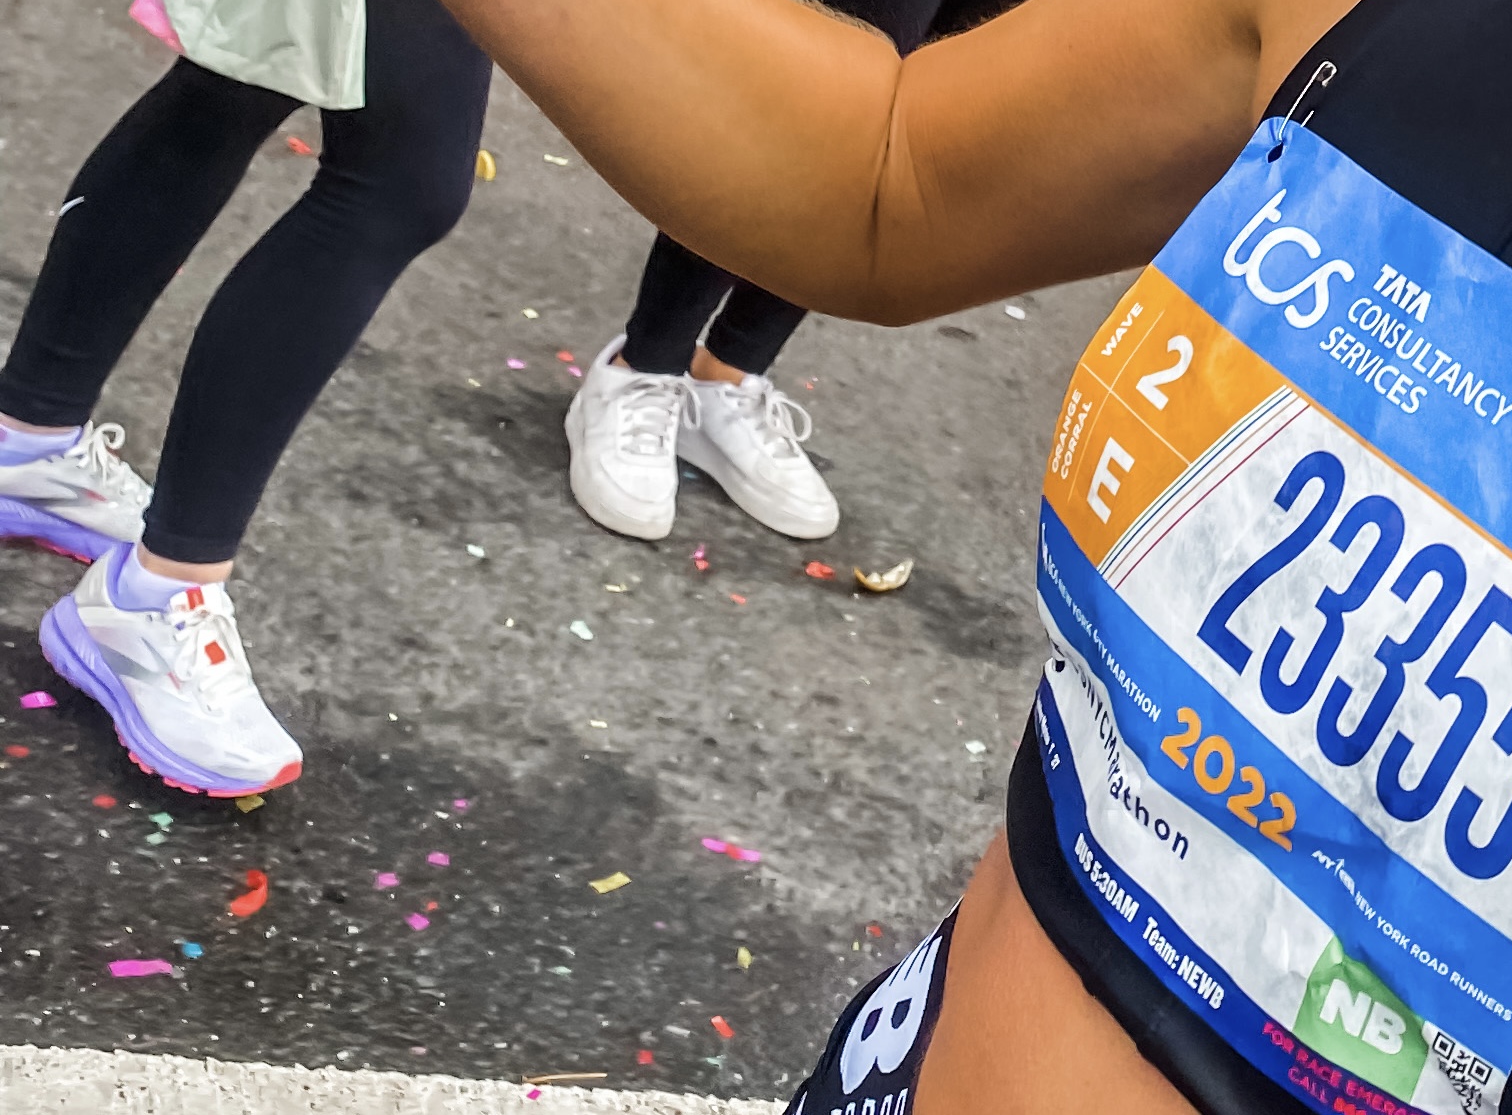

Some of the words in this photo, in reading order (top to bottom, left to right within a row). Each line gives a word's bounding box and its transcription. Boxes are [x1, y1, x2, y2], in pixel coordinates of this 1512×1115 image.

[1101, 302, 1144, 356] WAVE
[1373, 264, 1432, 322] TATA
[1135, 335, 1194, 411] 2
[1319, 326, 1428, 414] SERVICES
[1051, 389, 1082, 473] ORANGE
[1061, 400, 1093, 479] CORRAL
[1086, 436, 1136, 524] E
[1106, 654, 1162, 723] MARATHON
[1160, 707, 1298, 853] 2022
[1074, 833, 1094, 873] BUS
[1090, 860, 1140, 923] 5:30AM
[1142, 916, 1181, 969] Team:
[1176, 955, 1226, 1010] NEWB
[1354, 891, 1376, 920] NEW
[1376, 916, 1411, 949] YORK
[1410, 943, 1449, 976] ROAD
[1449, 971, 1512, 1022] RUNNERS
[1262, 1022, 1295, 1054] FOR
[1296, 1049, 1343, 1088] RACE
[1319, 978, 1407, 1055] NB
[1288, 1067, 1328, 1104] CALL
